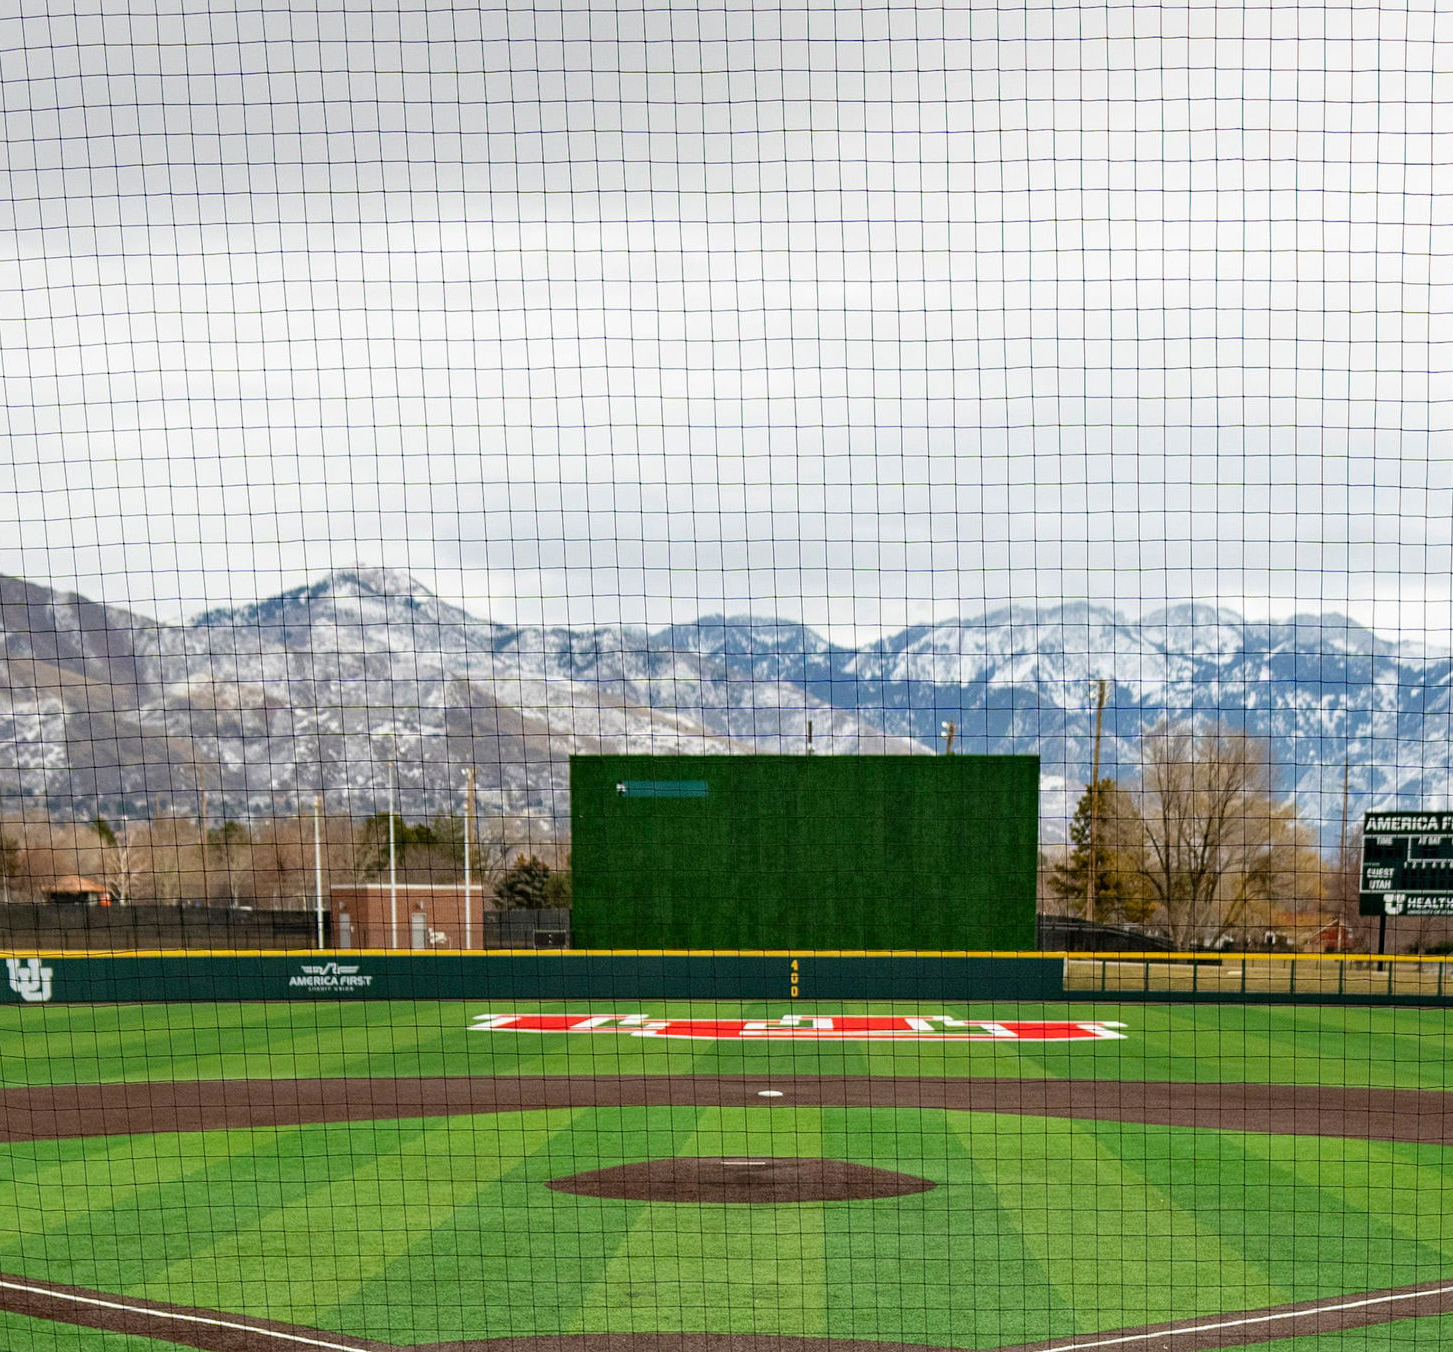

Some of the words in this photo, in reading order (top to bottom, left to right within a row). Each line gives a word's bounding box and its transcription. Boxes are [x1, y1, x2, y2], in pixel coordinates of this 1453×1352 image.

[1366, 816, 1439, 831] AMERICA
[1366, 868, 1395, 879] GUEST
[1369, 879, 1392, 889] UTAH
[288, 976, 338, 986] AMERICA
[339, 976, 373, 986] FIRST
[790, 959, 799, 998] 400
